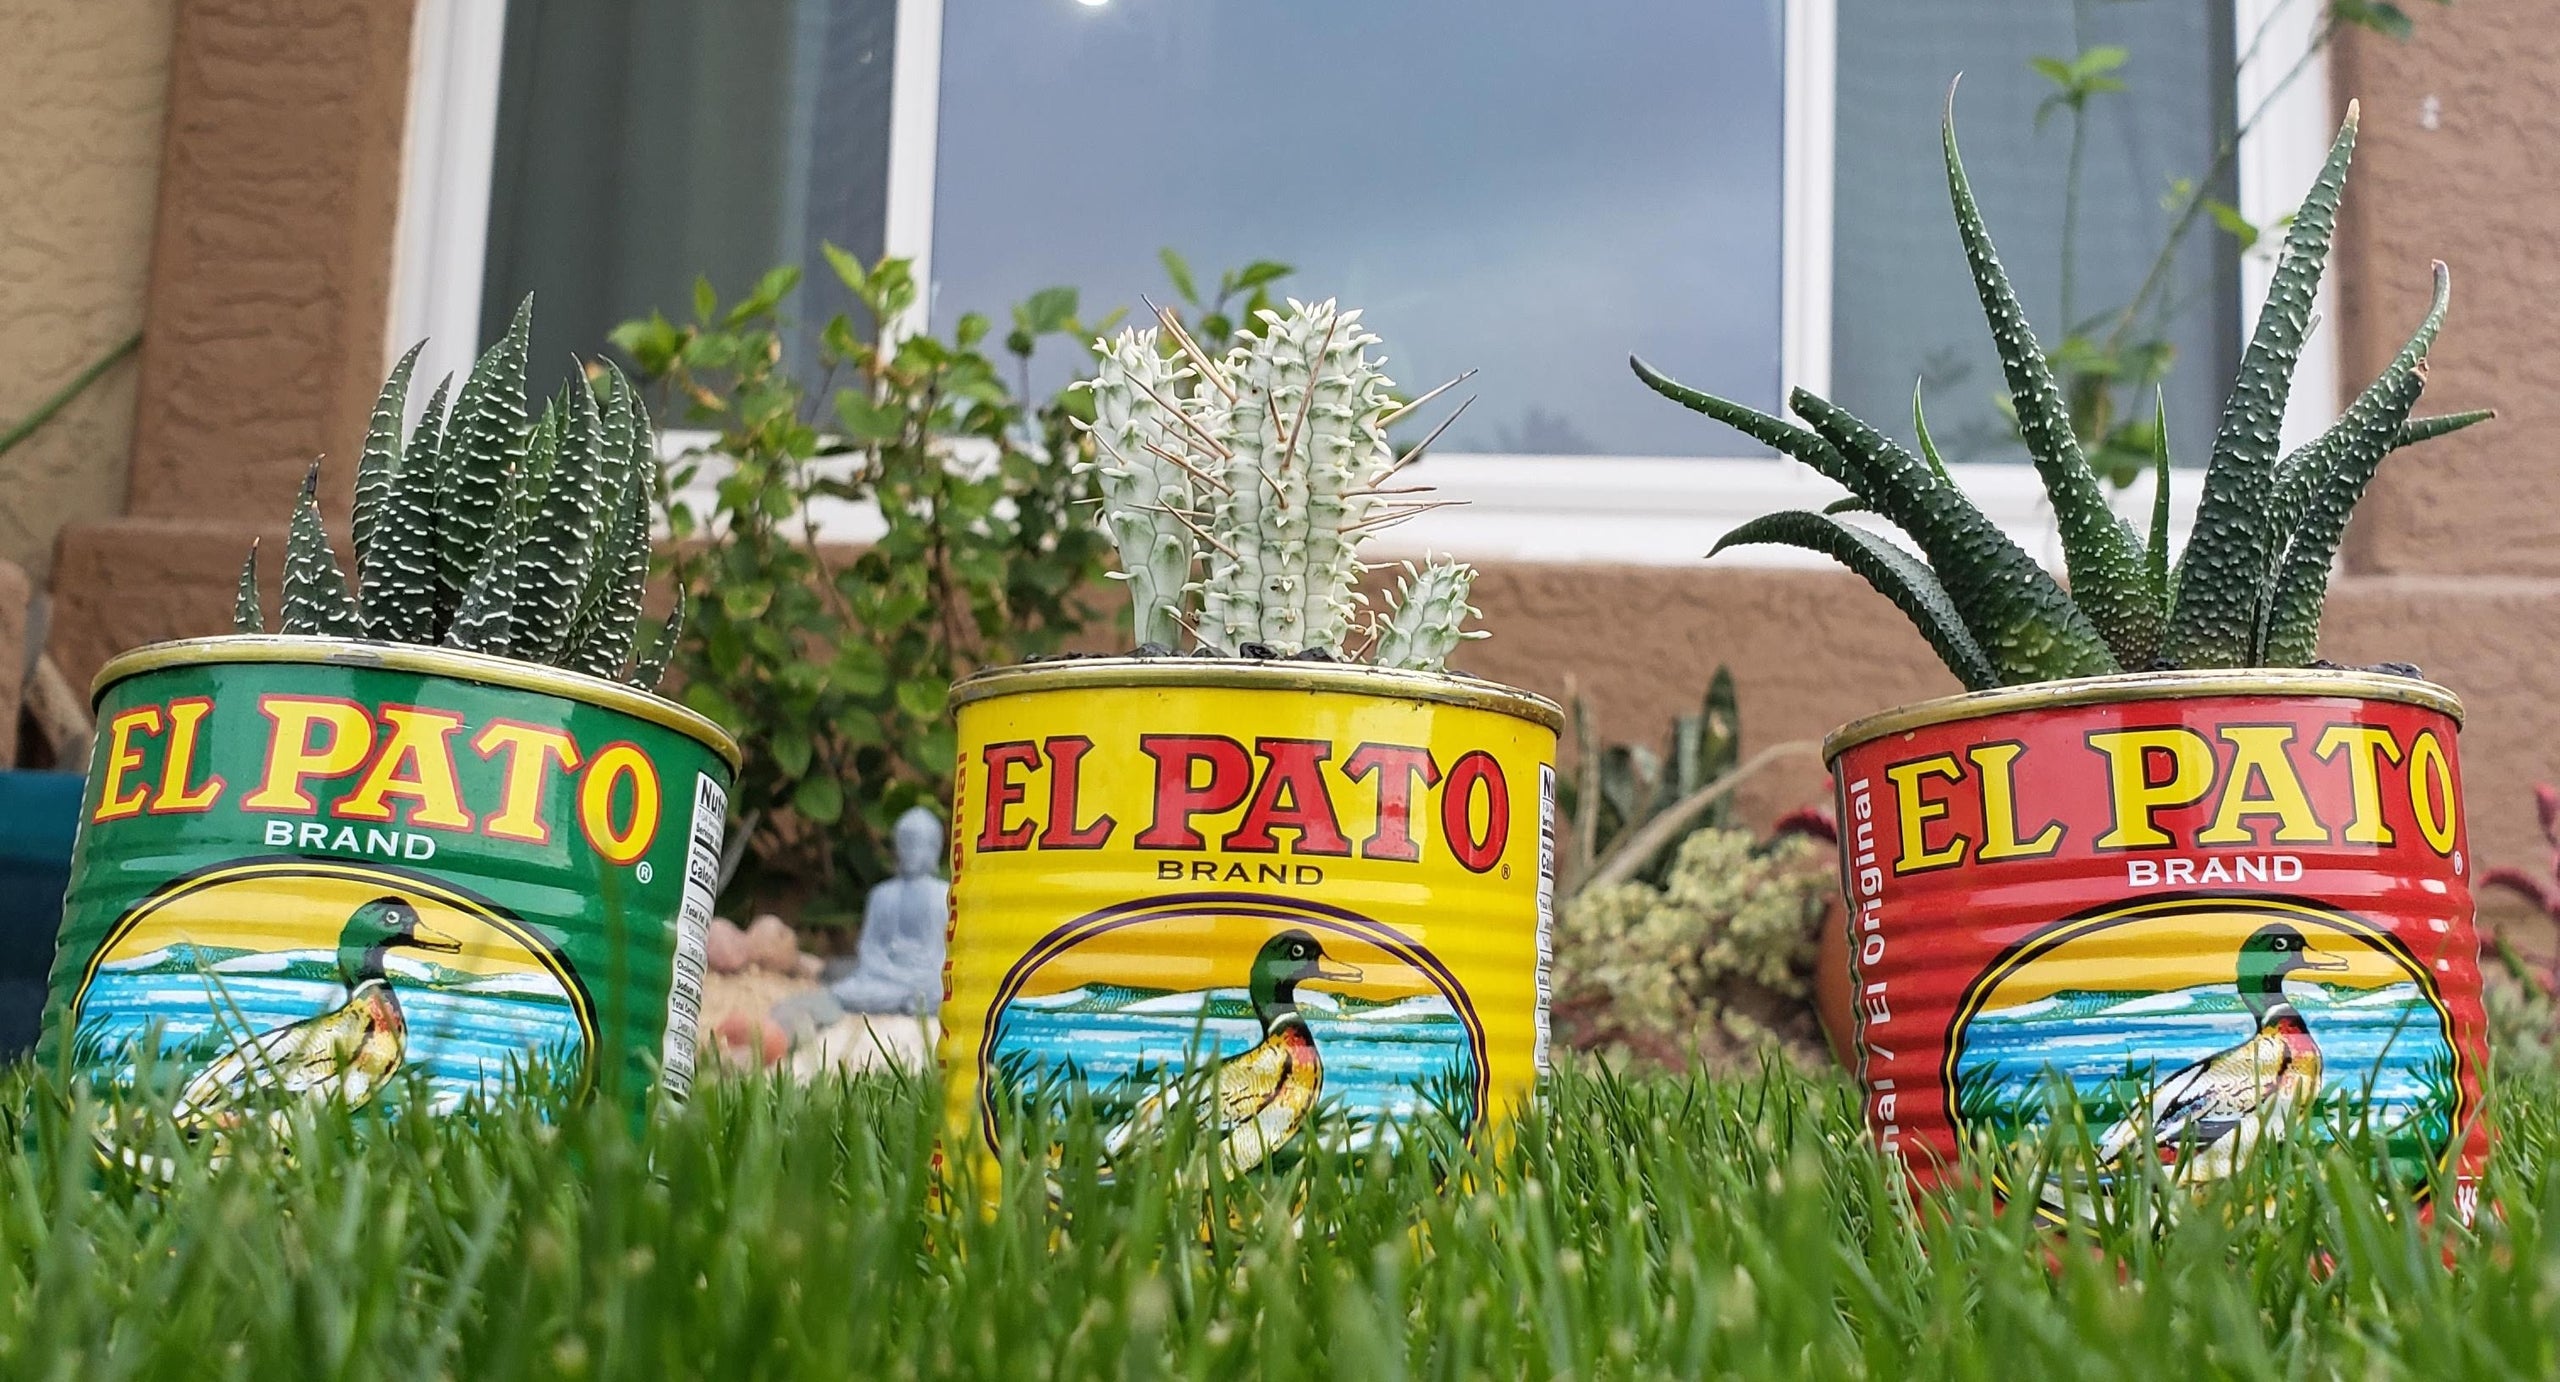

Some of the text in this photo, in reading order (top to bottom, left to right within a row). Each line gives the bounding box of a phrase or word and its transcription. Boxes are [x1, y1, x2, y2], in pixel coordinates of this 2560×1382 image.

[92, 693, 662, 866] EL PATO
[976, 733, 1511, 874] EL PATO
[1887, 722, 2460, 877] EL PATO
[264, 820, 437, 861] BRAND
[1158, 859, 1324, 886] BRAND
[1850, 777, 1887, 966] Original
[2127, 855, 2303, 888] BRAND
[1866, 981, 1892, 1025] El
